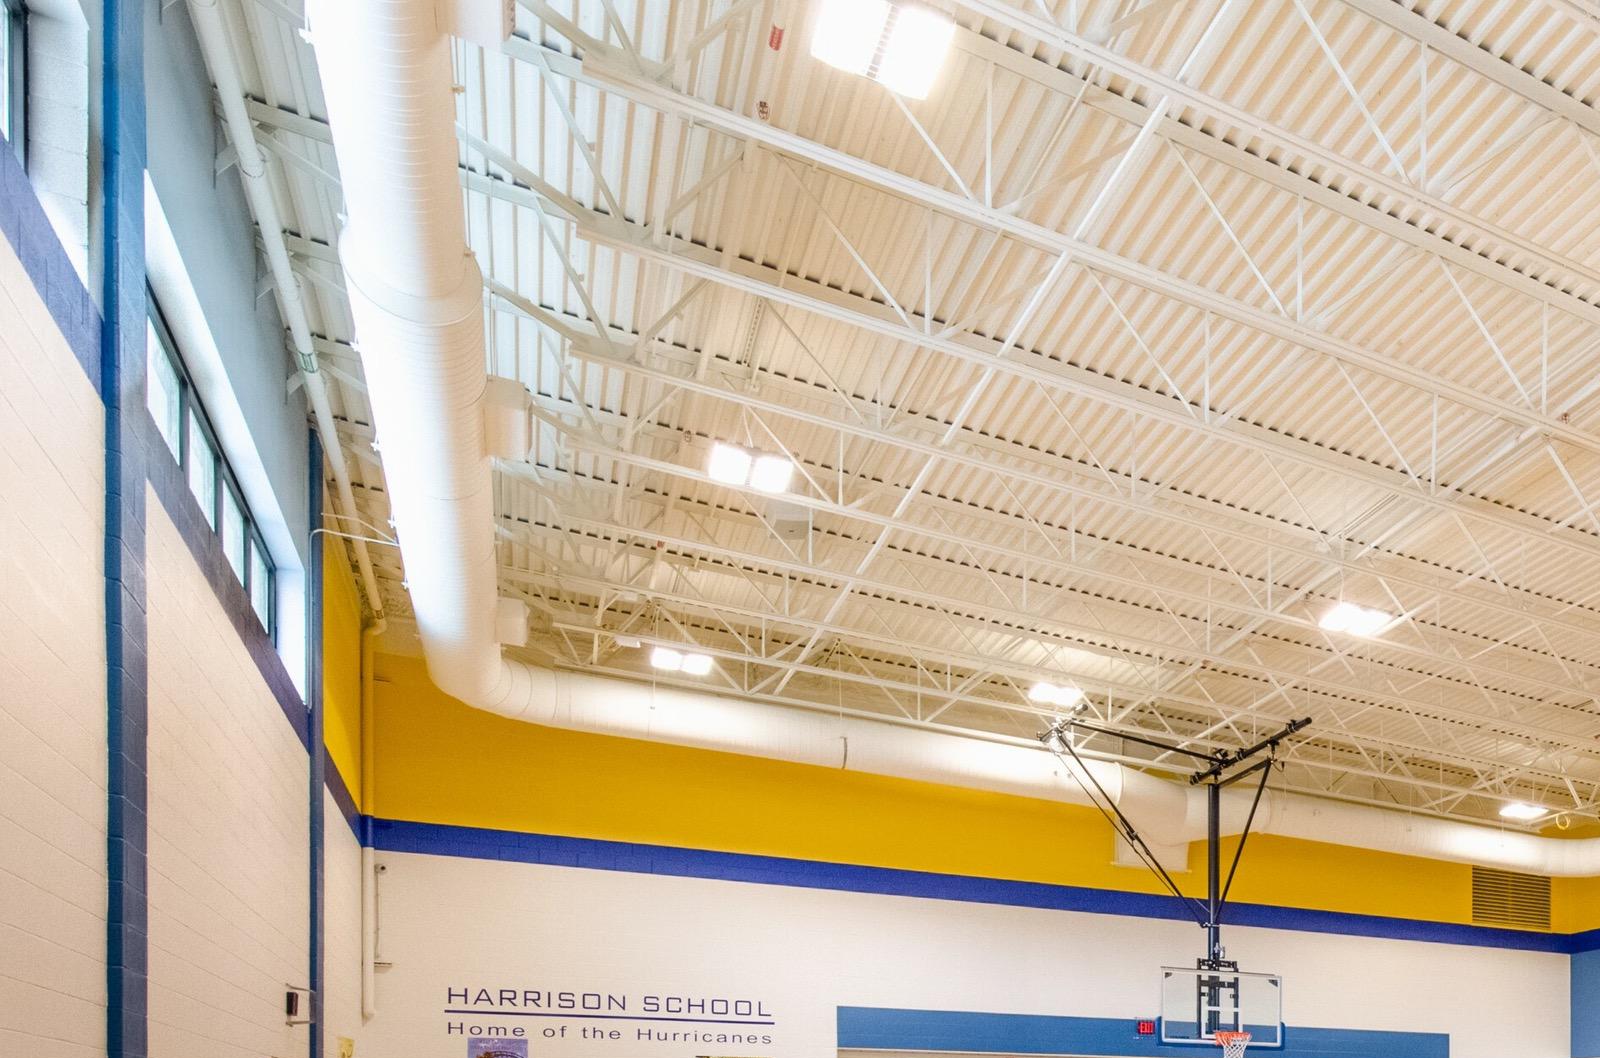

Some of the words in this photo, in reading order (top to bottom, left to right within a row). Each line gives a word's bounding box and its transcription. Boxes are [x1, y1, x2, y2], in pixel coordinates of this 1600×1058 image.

[447, 986, 626, 1011] HARRISON
[643, 995, 772, 1017] SCHOOL
[447, 1021, 526, 1037] Home
[542, 1025, 568, 1038] of
[582, 1026, 622, 1040] the
[637, 1028, 773, 1045] Hurricanes
[1140, 1022, 1154, 1033] EXIT
